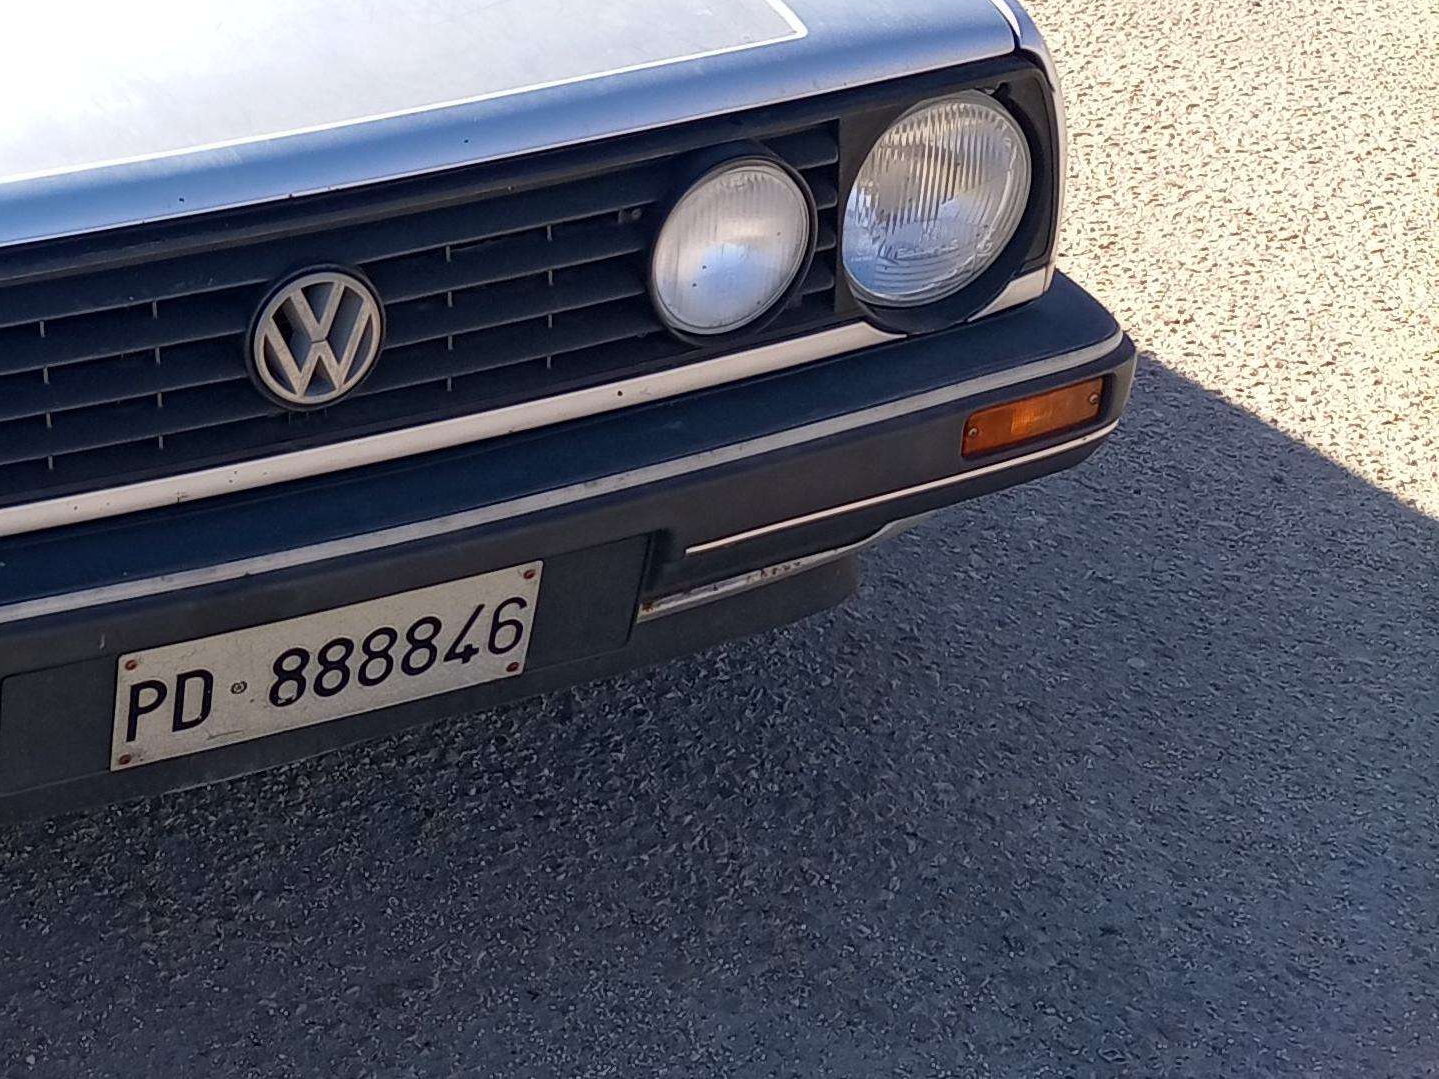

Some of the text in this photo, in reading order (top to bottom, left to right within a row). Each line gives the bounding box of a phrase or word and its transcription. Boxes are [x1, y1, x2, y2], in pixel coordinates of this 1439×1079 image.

[254, 272, 381, 404] VW
[126, 596, 528, 743] PD 888846
